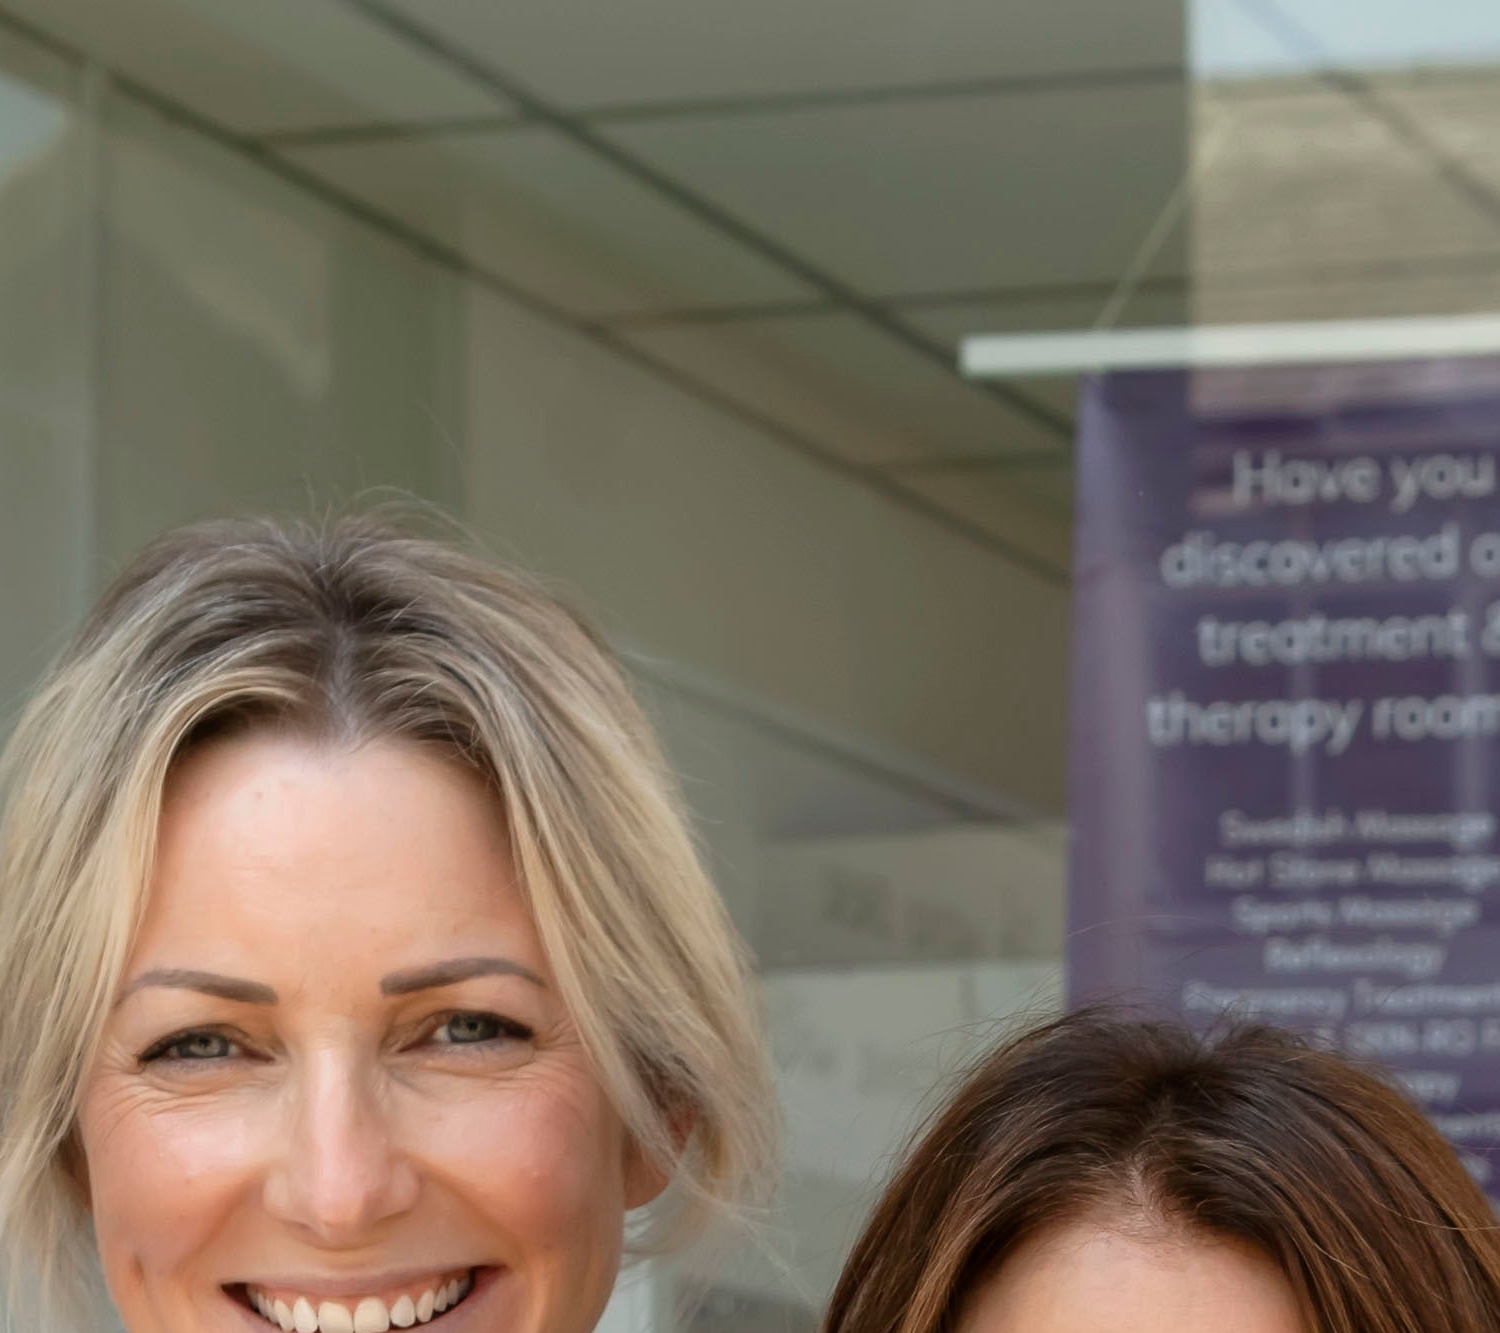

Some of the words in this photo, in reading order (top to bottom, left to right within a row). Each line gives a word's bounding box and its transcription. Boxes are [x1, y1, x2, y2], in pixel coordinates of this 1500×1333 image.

[1235, 450, 1380, 506] Have
[1389, 453, 1495, 512] you
[1160, 521, 1460, 588] discovered
[1197, 606, 1470, 667] treatment
[1147, 690, 1362, 755] therapy
[1219, 809, 1346, 847] Swedish
[1355, 809, 1495, 850] Massage
[1339, 895, 1480, 936] Massage
